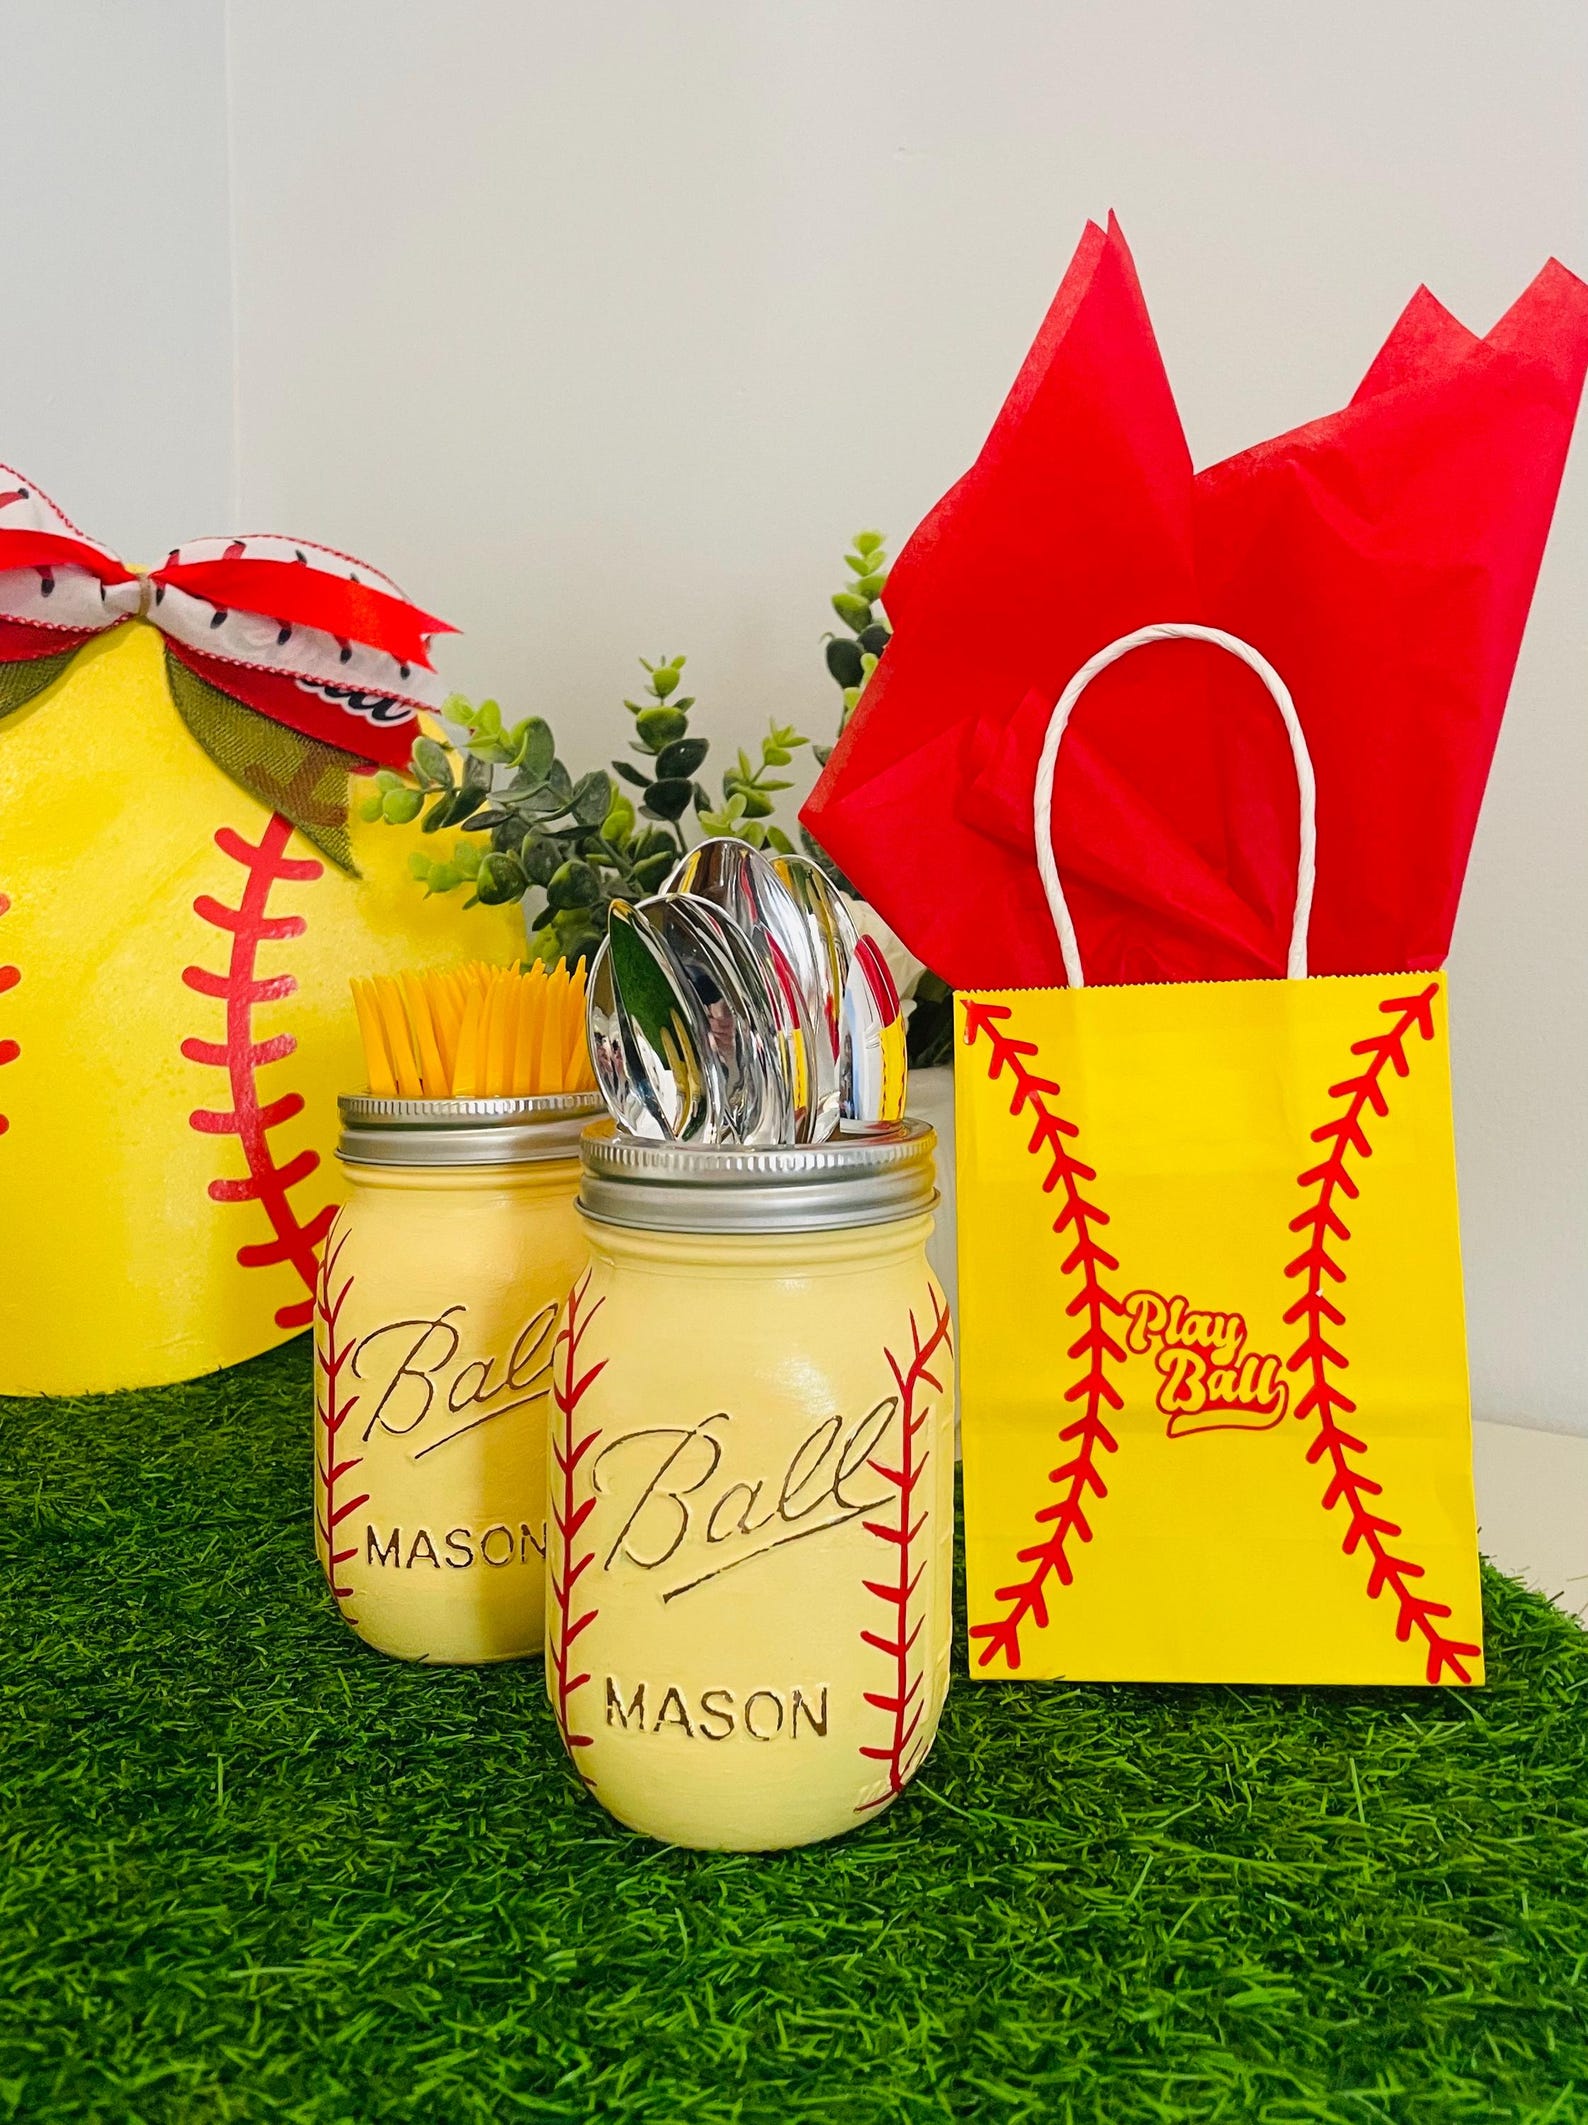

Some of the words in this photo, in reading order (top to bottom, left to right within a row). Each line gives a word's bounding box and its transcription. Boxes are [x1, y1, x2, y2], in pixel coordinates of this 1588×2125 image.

[1122, 1289, 1248, 1368] Play
[351, 1304, 559, 1442] Bal
[1155, 1347, 1290, 1438] Ball
[592, 1395, 899, 1573] Ball
[366, 1521, 547, 1569] MASON
[605, 1676, 829, 1742] MASON
